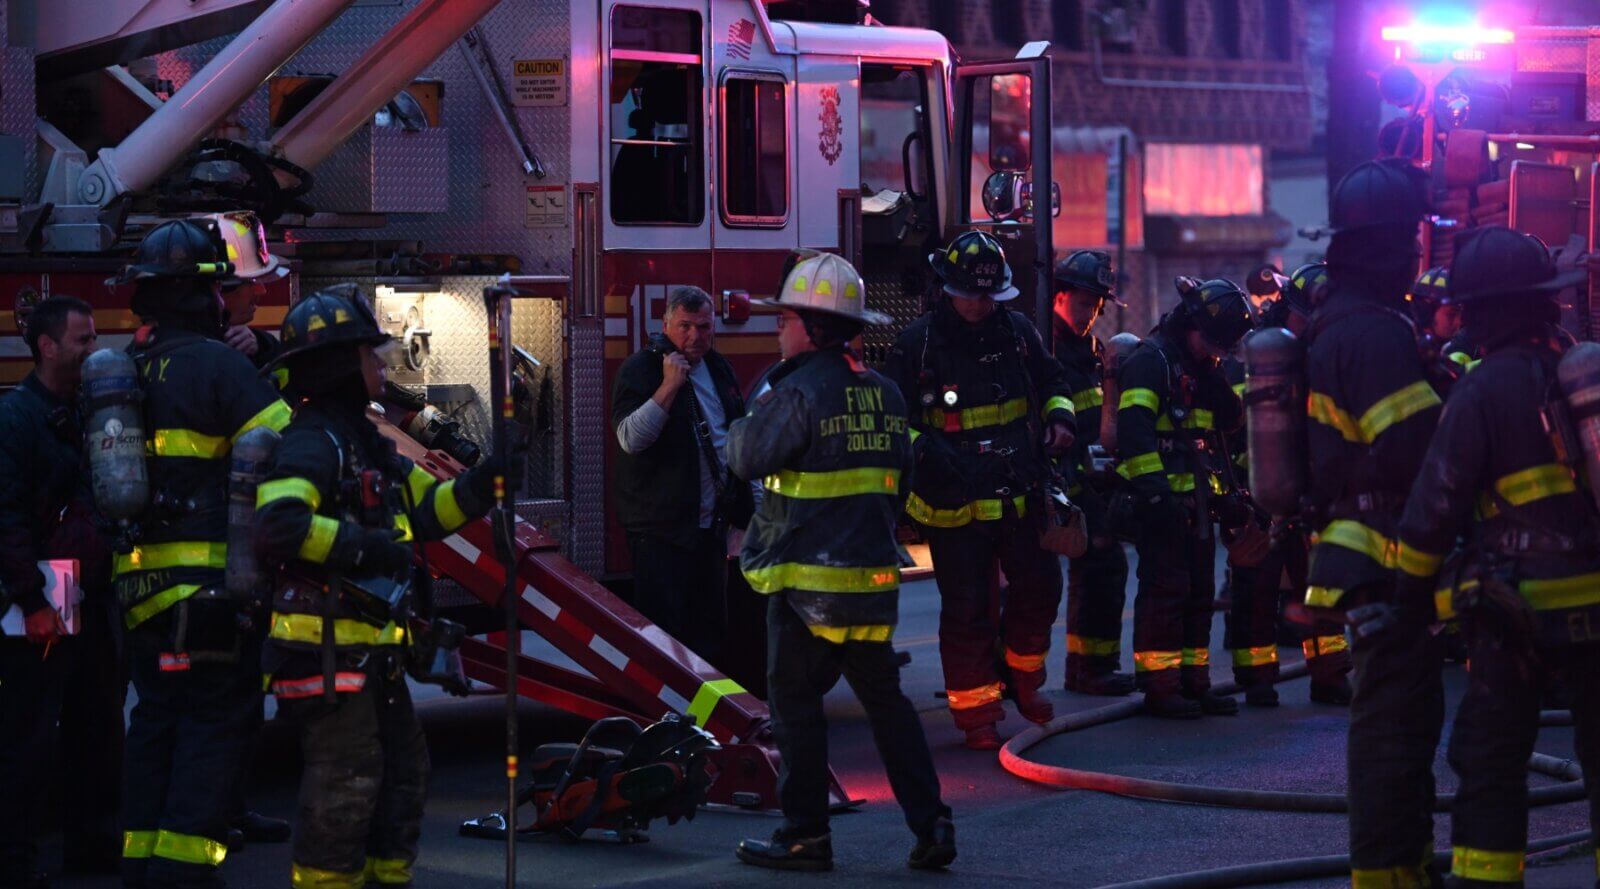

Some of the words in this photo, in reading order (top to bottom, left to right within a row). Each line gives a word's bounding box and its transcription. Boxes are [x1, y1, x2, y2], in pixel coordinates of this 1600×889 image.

[517, 62, 560, 74] CAUTION
[845, 386, 884, 412] FDNY
[820, 412, 876, 437] BATTALION
